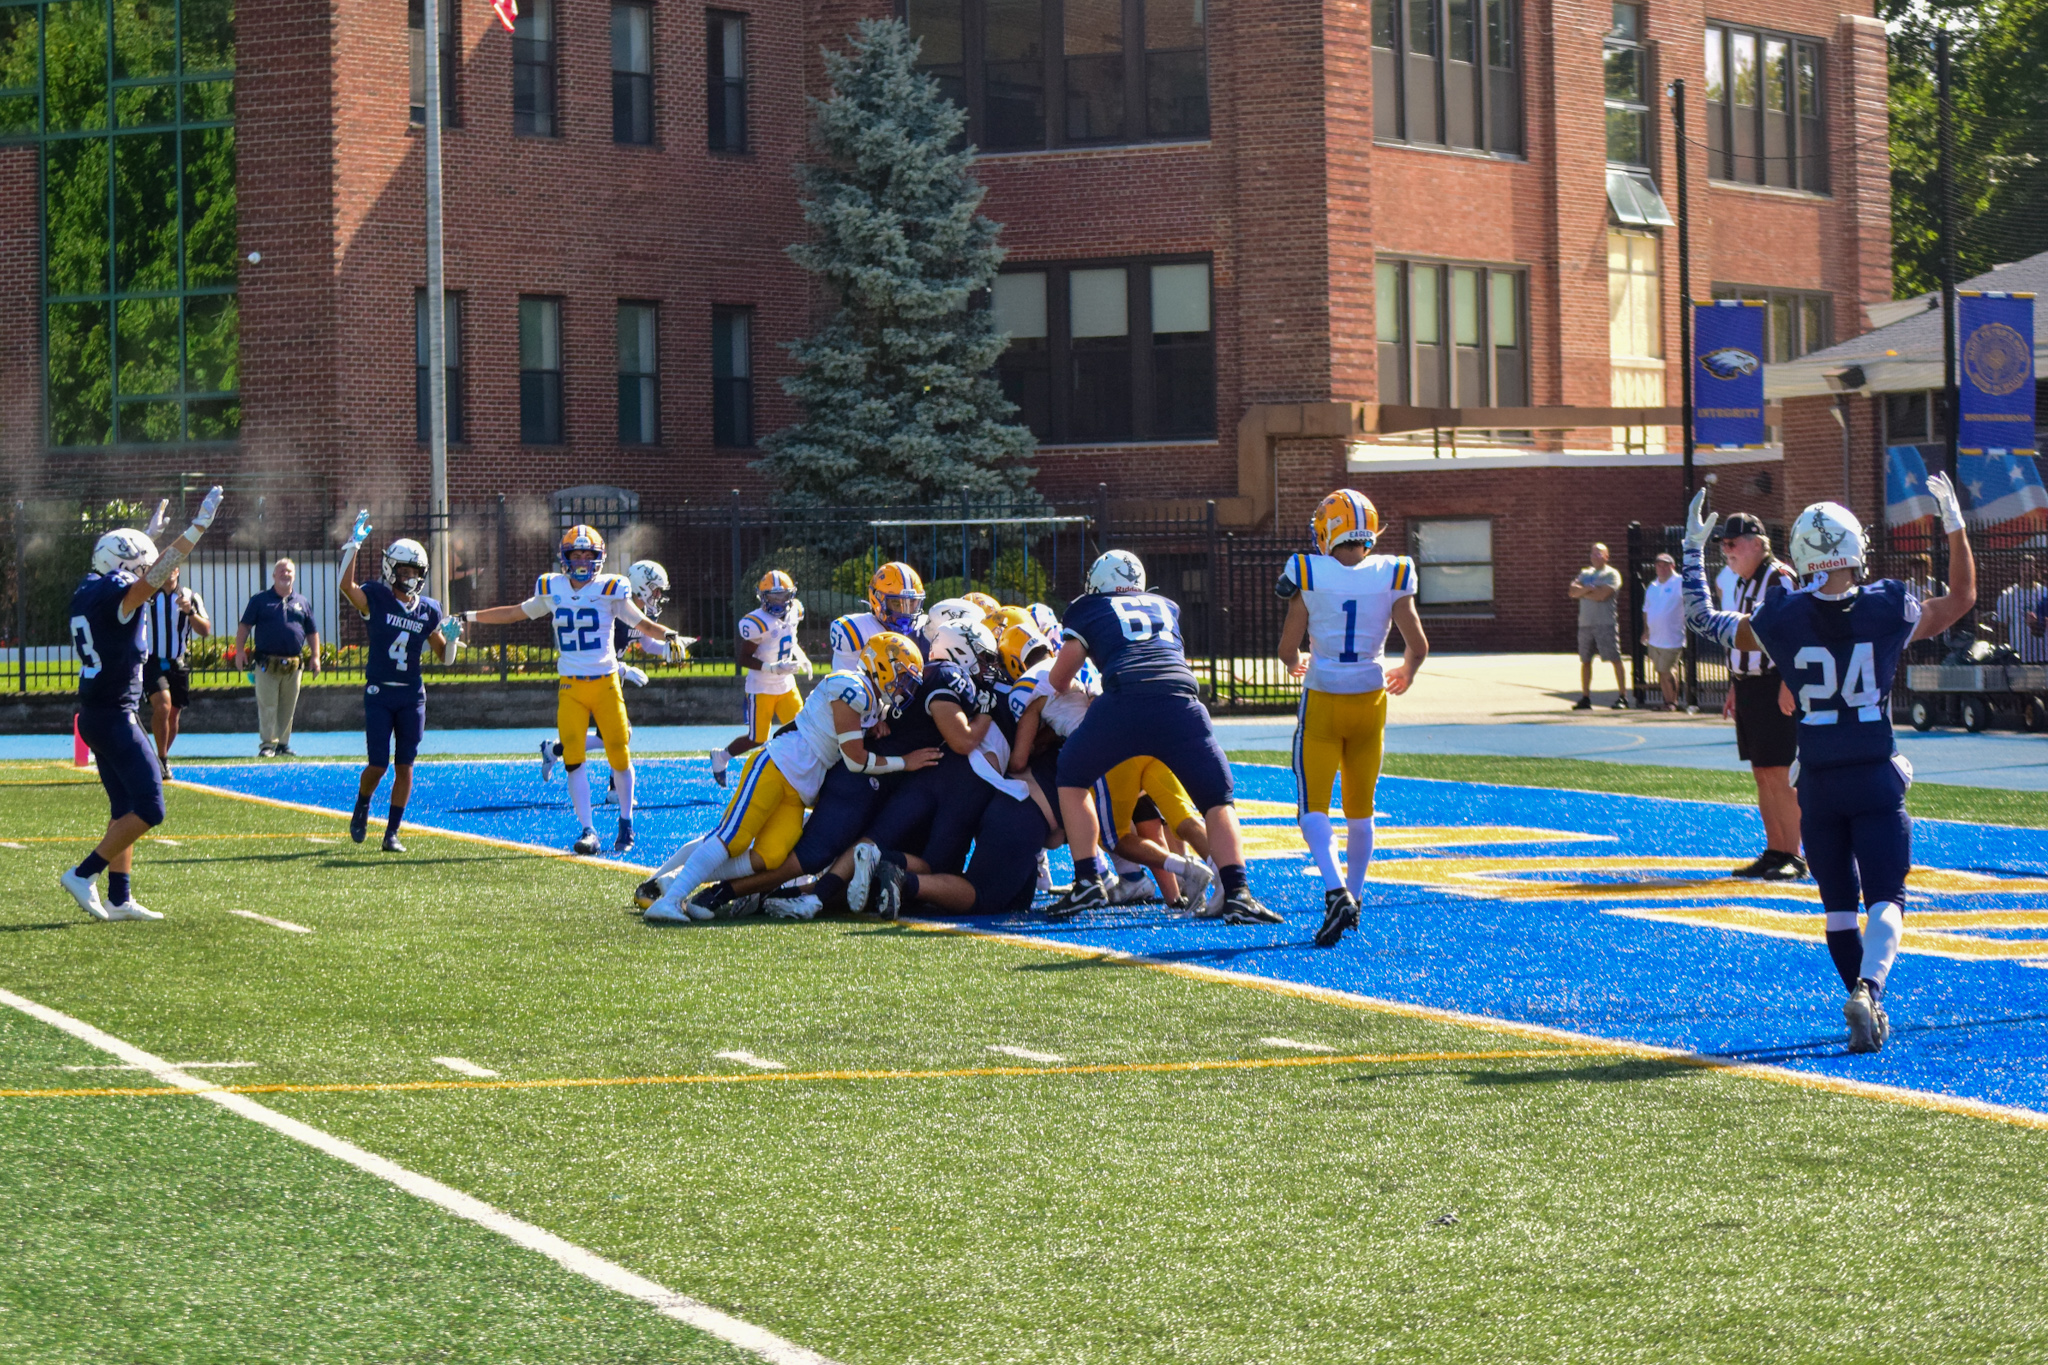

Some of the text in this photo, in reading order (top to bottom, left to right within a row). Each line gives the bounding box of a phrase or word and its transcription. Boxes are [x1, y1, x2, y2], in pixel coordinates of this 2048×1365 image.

[1697, 408, 1760, 418] INTEGRITY
[1807, 558, 1848, 572] Riddell
[386, 612, 424, 634] VIKINGS
[555, 607, 602, 652] 22
[742, 624, 750, 638] 6
[1110, 595, 1175, 643] 67
[1339, 599, 1358, 663] 1
[389, 630, 411, 671] 4
[830, 626, 844, 652] 51
[947, 671, 968, 694] 79
[1793, 641, 1883, 727] 24
[839, 687, 857, 705] 8
